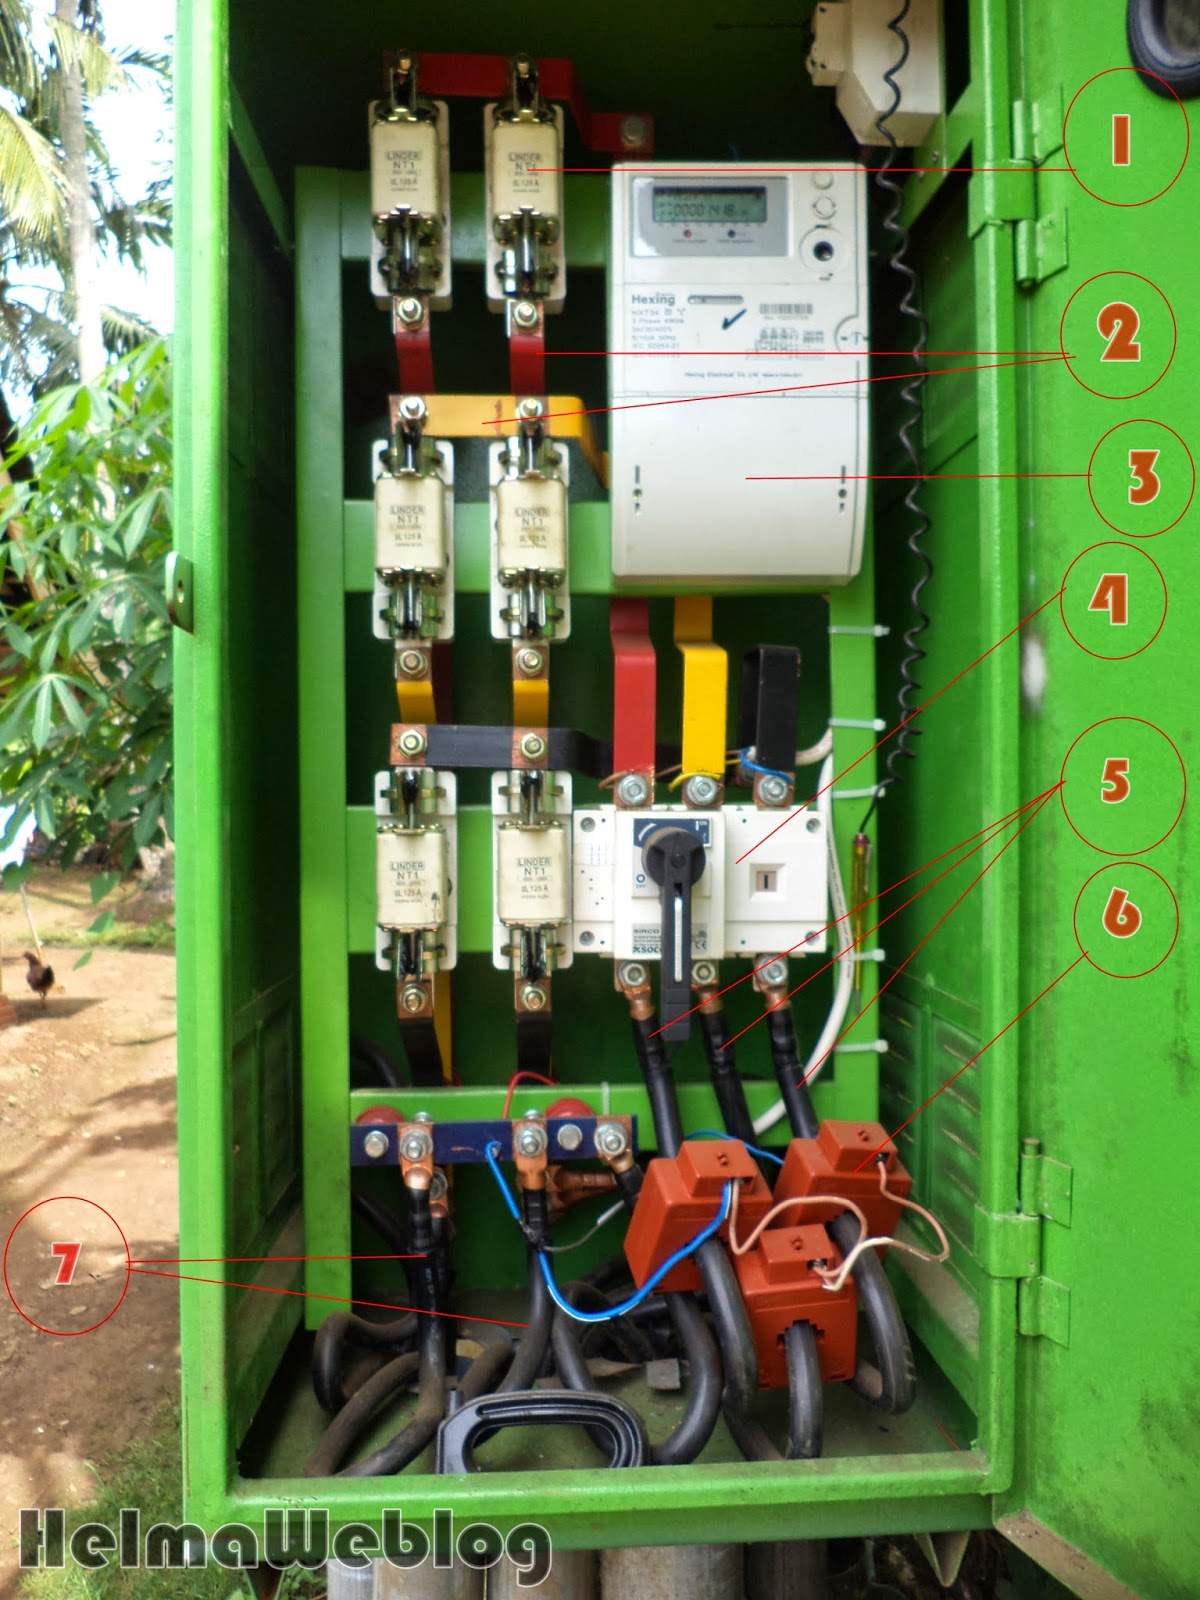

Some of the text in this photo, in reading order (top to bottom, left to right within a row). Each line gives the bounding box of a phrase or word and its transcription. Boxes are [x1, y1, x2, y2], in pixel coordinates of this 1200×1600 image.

[631, 294, 675, 306] Hexing
[391, 506, 424, 515] LINDER
[391, 861, 424, 871] LINDER
[517, 857, 551, 867] LINDER
